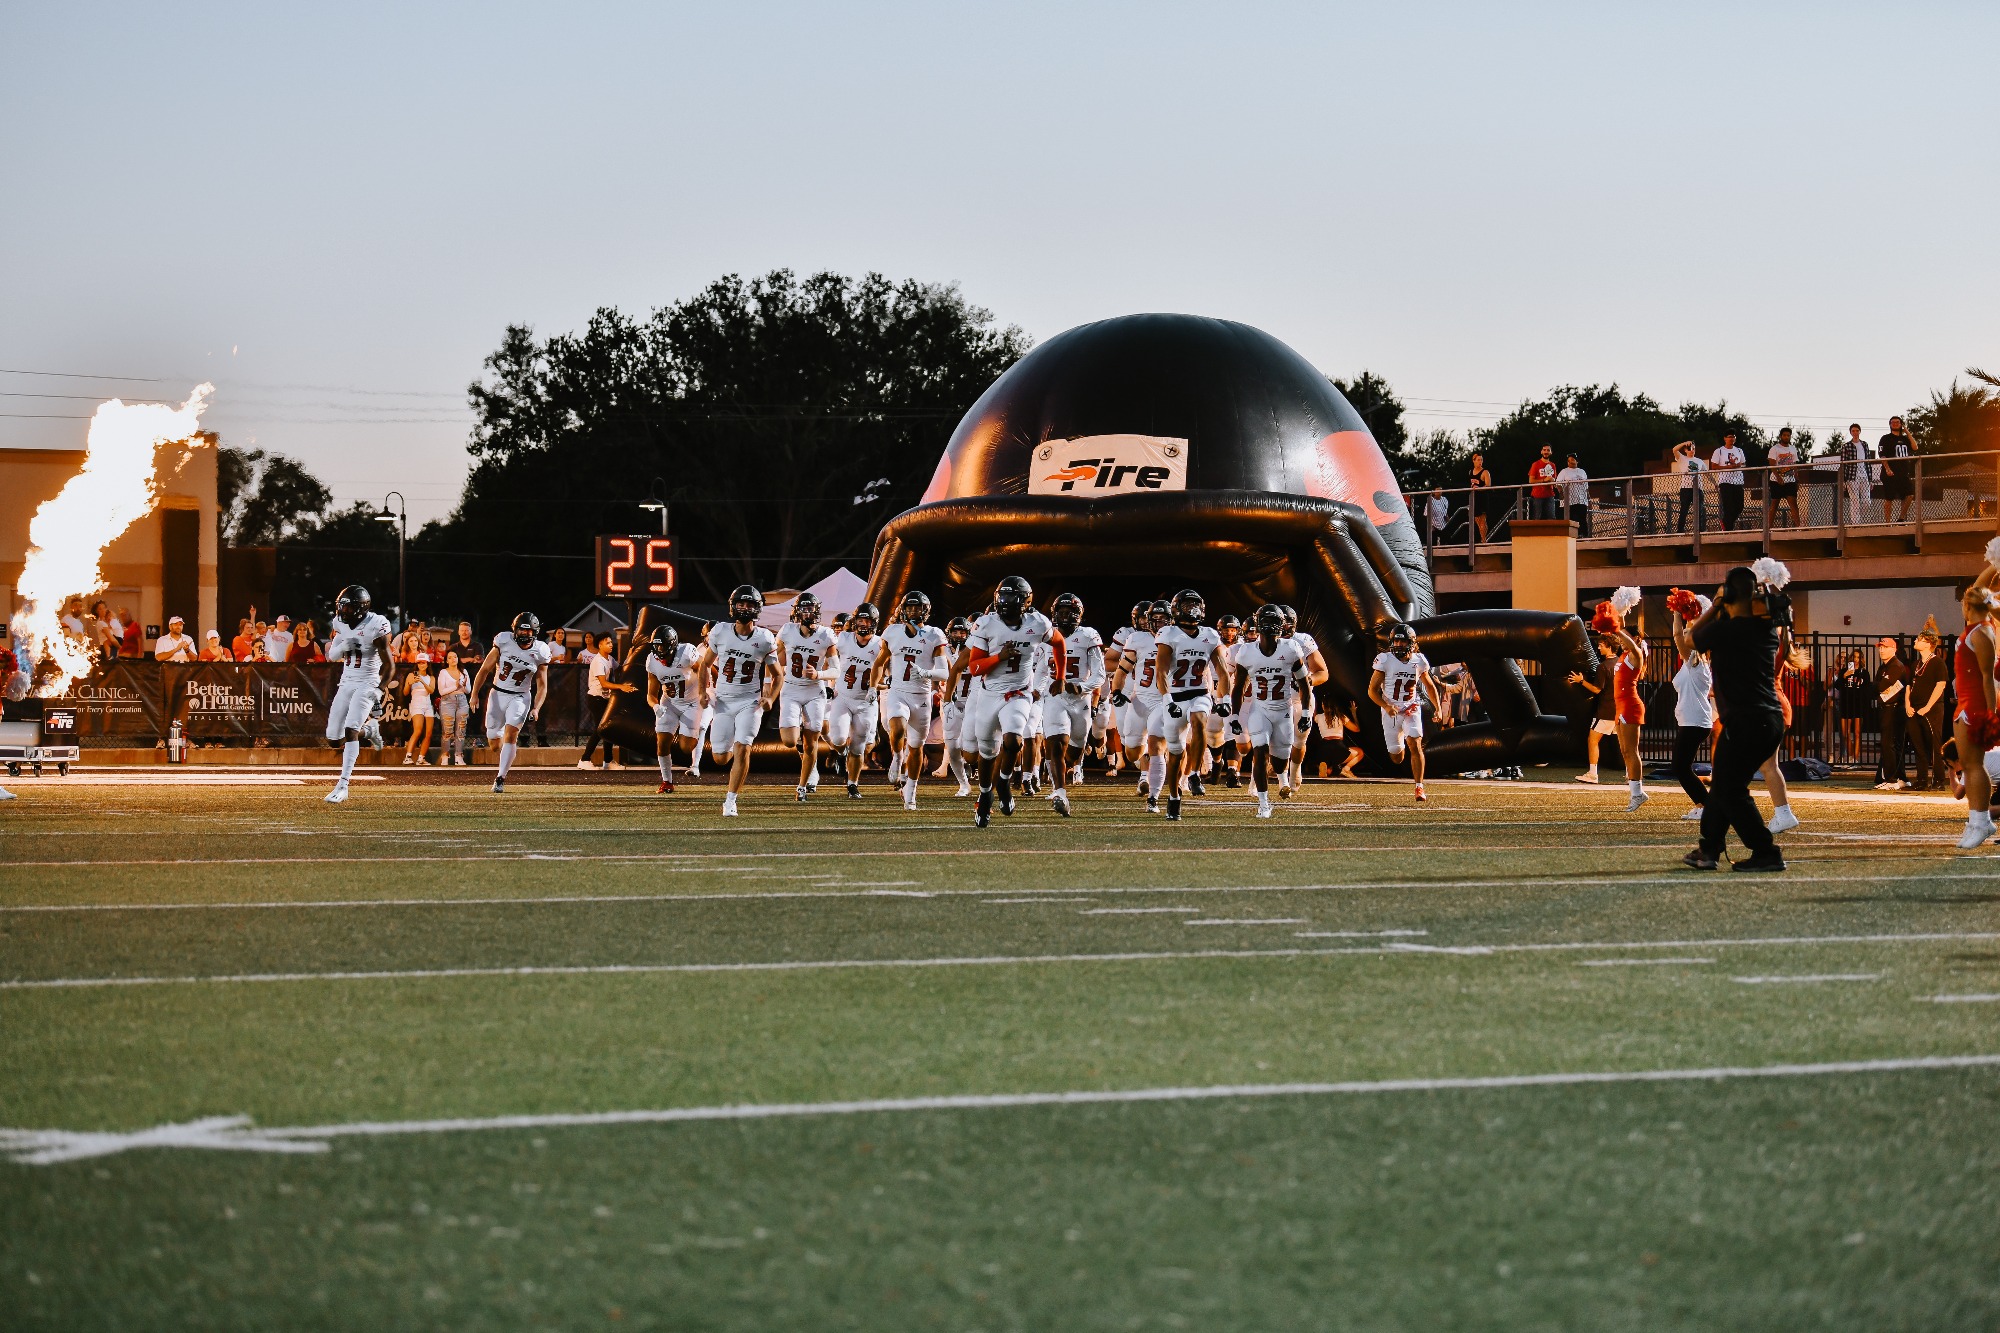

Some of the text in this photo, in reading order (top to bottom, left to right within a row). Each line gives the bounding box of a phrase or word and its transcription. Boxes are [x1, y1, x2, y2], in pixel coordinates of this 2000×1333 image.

[1043, 458, 1170, 491] Fire
[607, 539, 674, 592] 25
[724, 648, 753, 659] Fire
[1178, 649, 1206, 657] Fire
[498, 660, 532, 687] 34
[722, 657, 756, 684] 49
[902, 654, 916, 681] 7
[1172, 659, 1207, 687] 29
[1255, 666, 1283, 675] Fire
[77, 684, 127, 699] CLINIC
[186, 680, 233, 696] Better
[269, 687, 299, 699] FINE
[1255, 675, 1286, 701] 32
[86, 705, 104, 715] Every
[105, 704, 142, 713] Generation
[200, 693, 255, 710] Homes
[269, 702, 313, 714] LIVING
[46, 716, 75, 729] Fire
